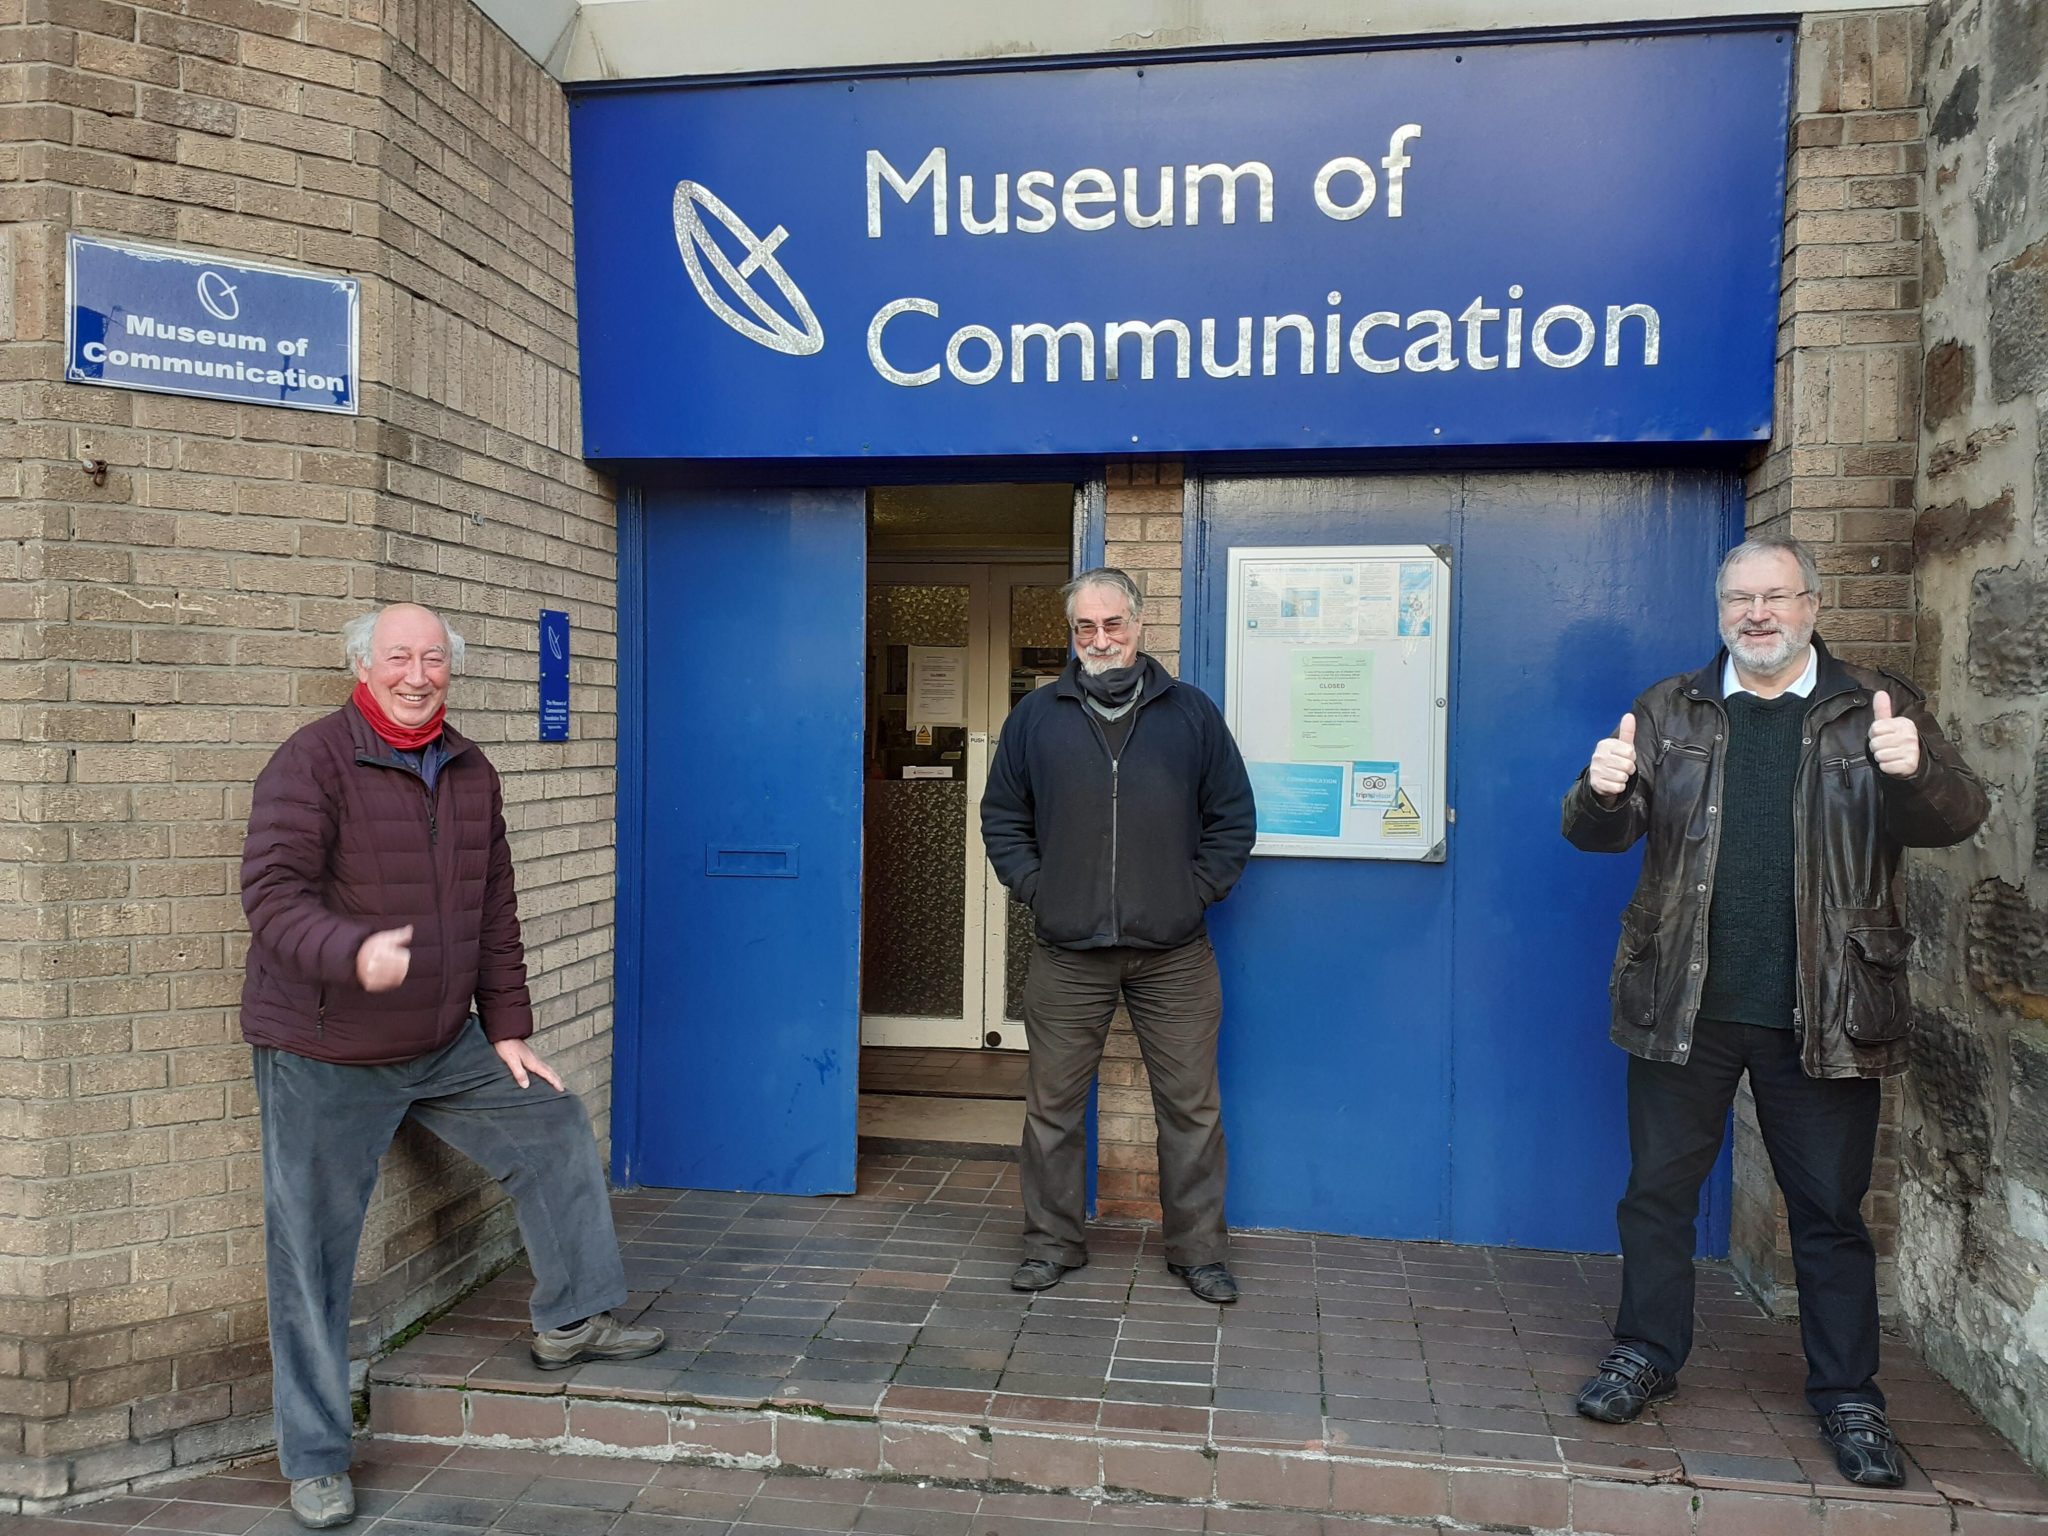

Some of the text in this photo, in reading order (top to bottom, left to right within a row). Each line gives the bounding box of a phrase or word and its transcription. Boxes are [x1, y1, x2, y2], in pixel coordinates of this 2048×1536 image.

[866, 123, 1422, 238] Museum of
[83, 341, 345, 392] Communication
[126, 314, 309, 357] Museum of
[866, 284, 1660, 387] Communication
